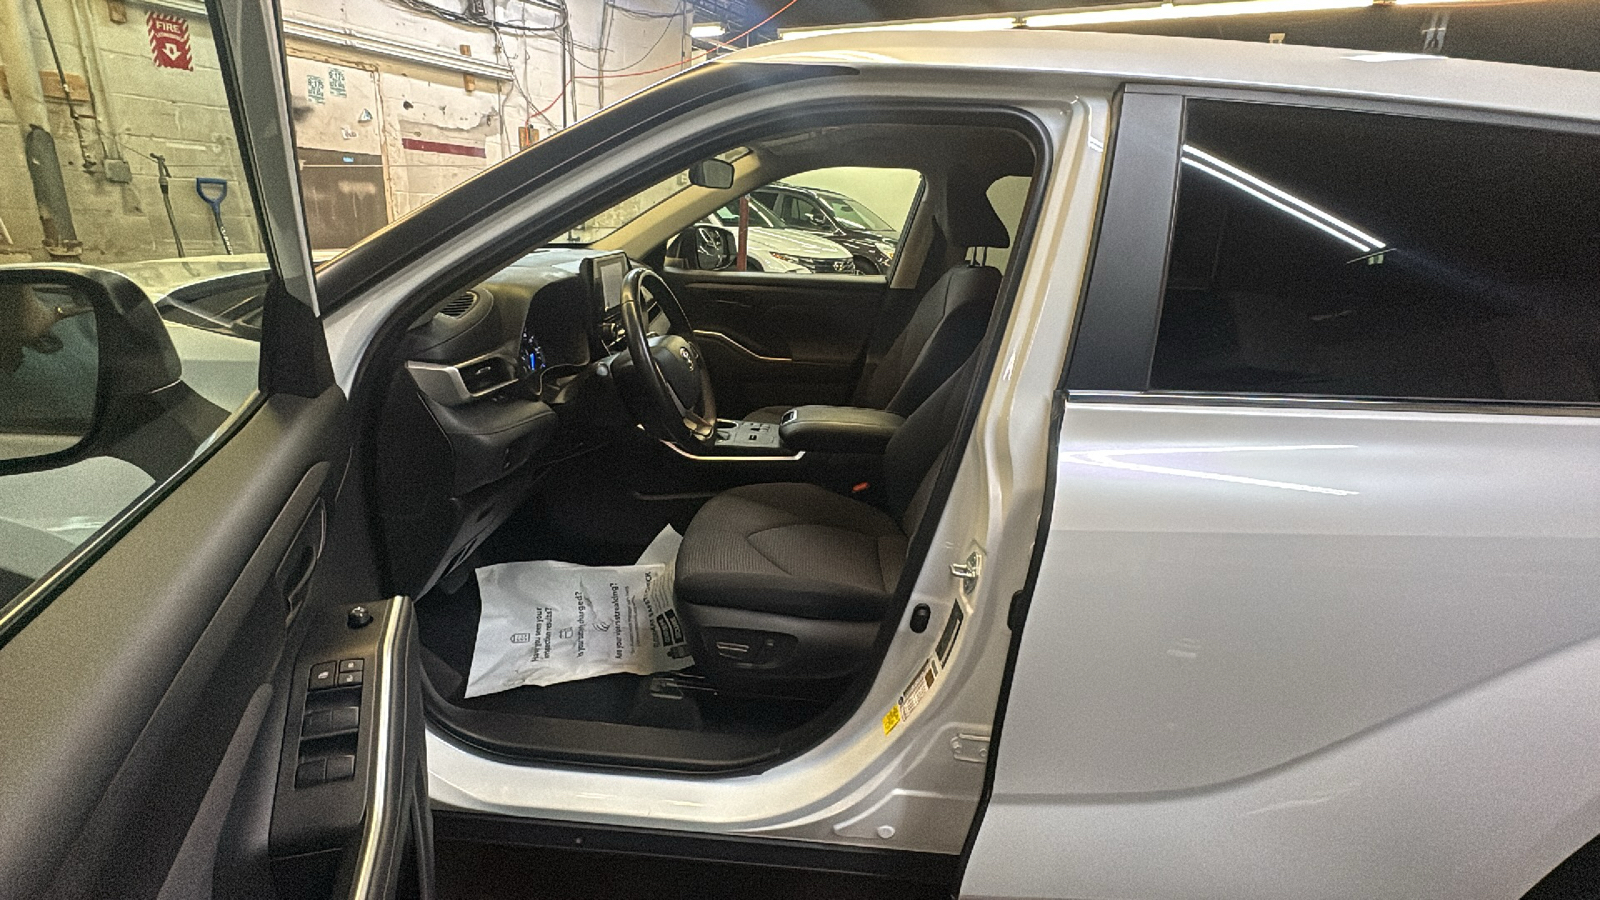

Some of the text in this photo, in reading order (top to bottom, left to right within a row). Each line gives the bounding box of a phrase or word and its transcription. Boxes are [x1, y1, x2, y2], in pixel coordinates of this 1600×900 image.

[156, 21, 181, 34] FIRE
[575, 591, 586, 624] charged?
[609, 583, 620, 620] streaking?
[534, 637, 542, 647] you
[615, 637, 624, 649] your
[614, 650, 622, 659] Are
